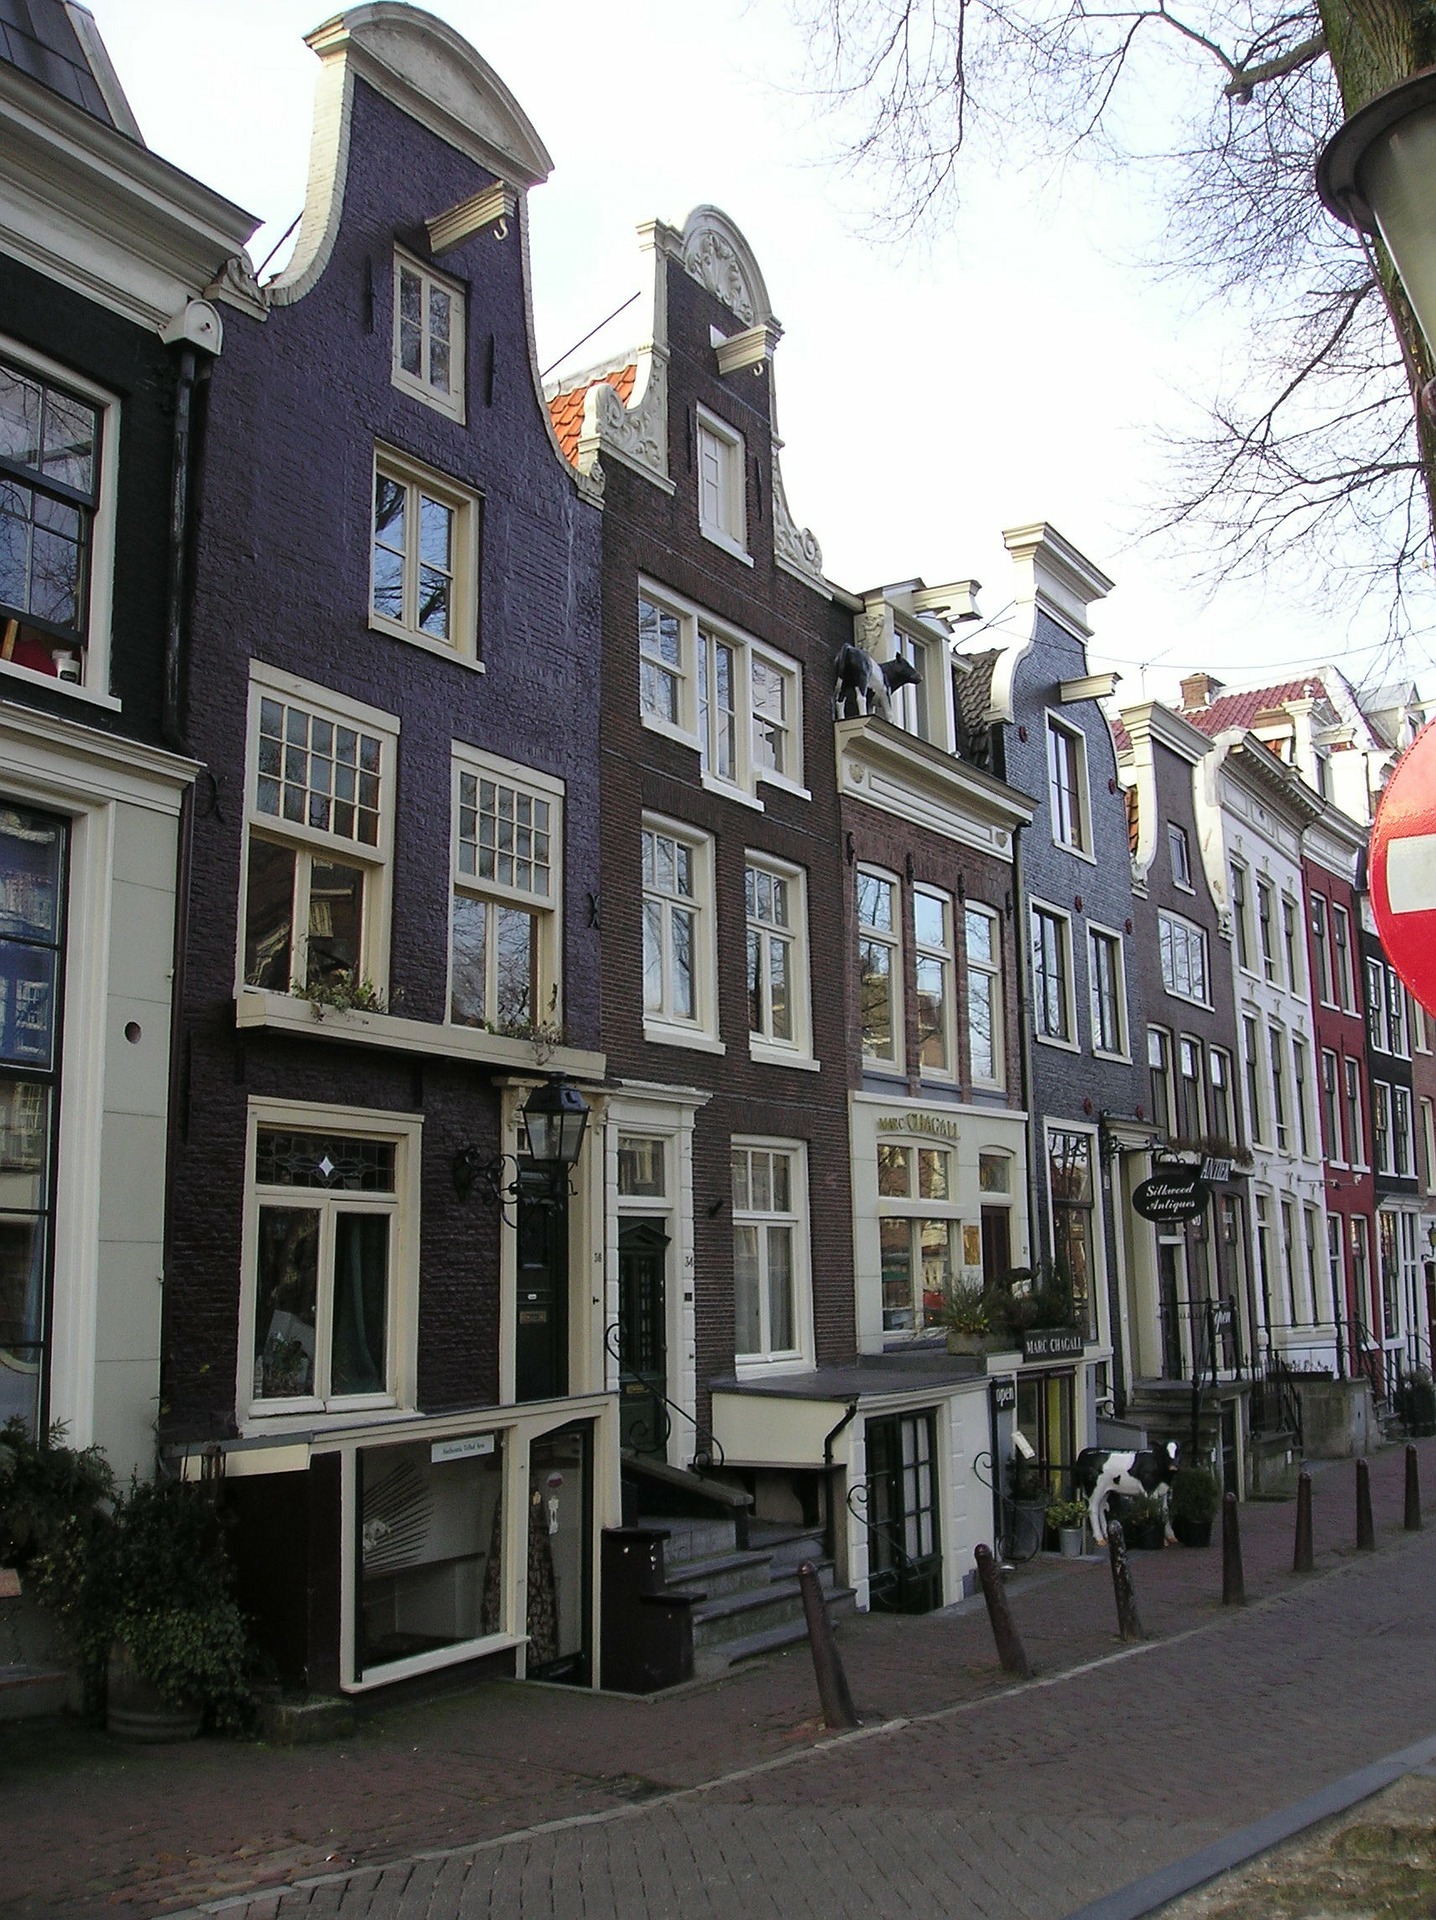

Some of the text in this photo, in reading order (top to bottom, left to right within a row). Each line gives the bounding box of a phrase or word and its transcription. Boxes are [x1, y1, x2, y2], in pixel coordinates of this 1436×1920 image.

[877, 1111, 961, 1140] MARC CHAGALL
[1146, 1182, 1195, 1197] Silkwood
[1146, 1199, 1196, 1213] Antiques
[1026, 1336, 1081, 1354] MARC CHAGALL
